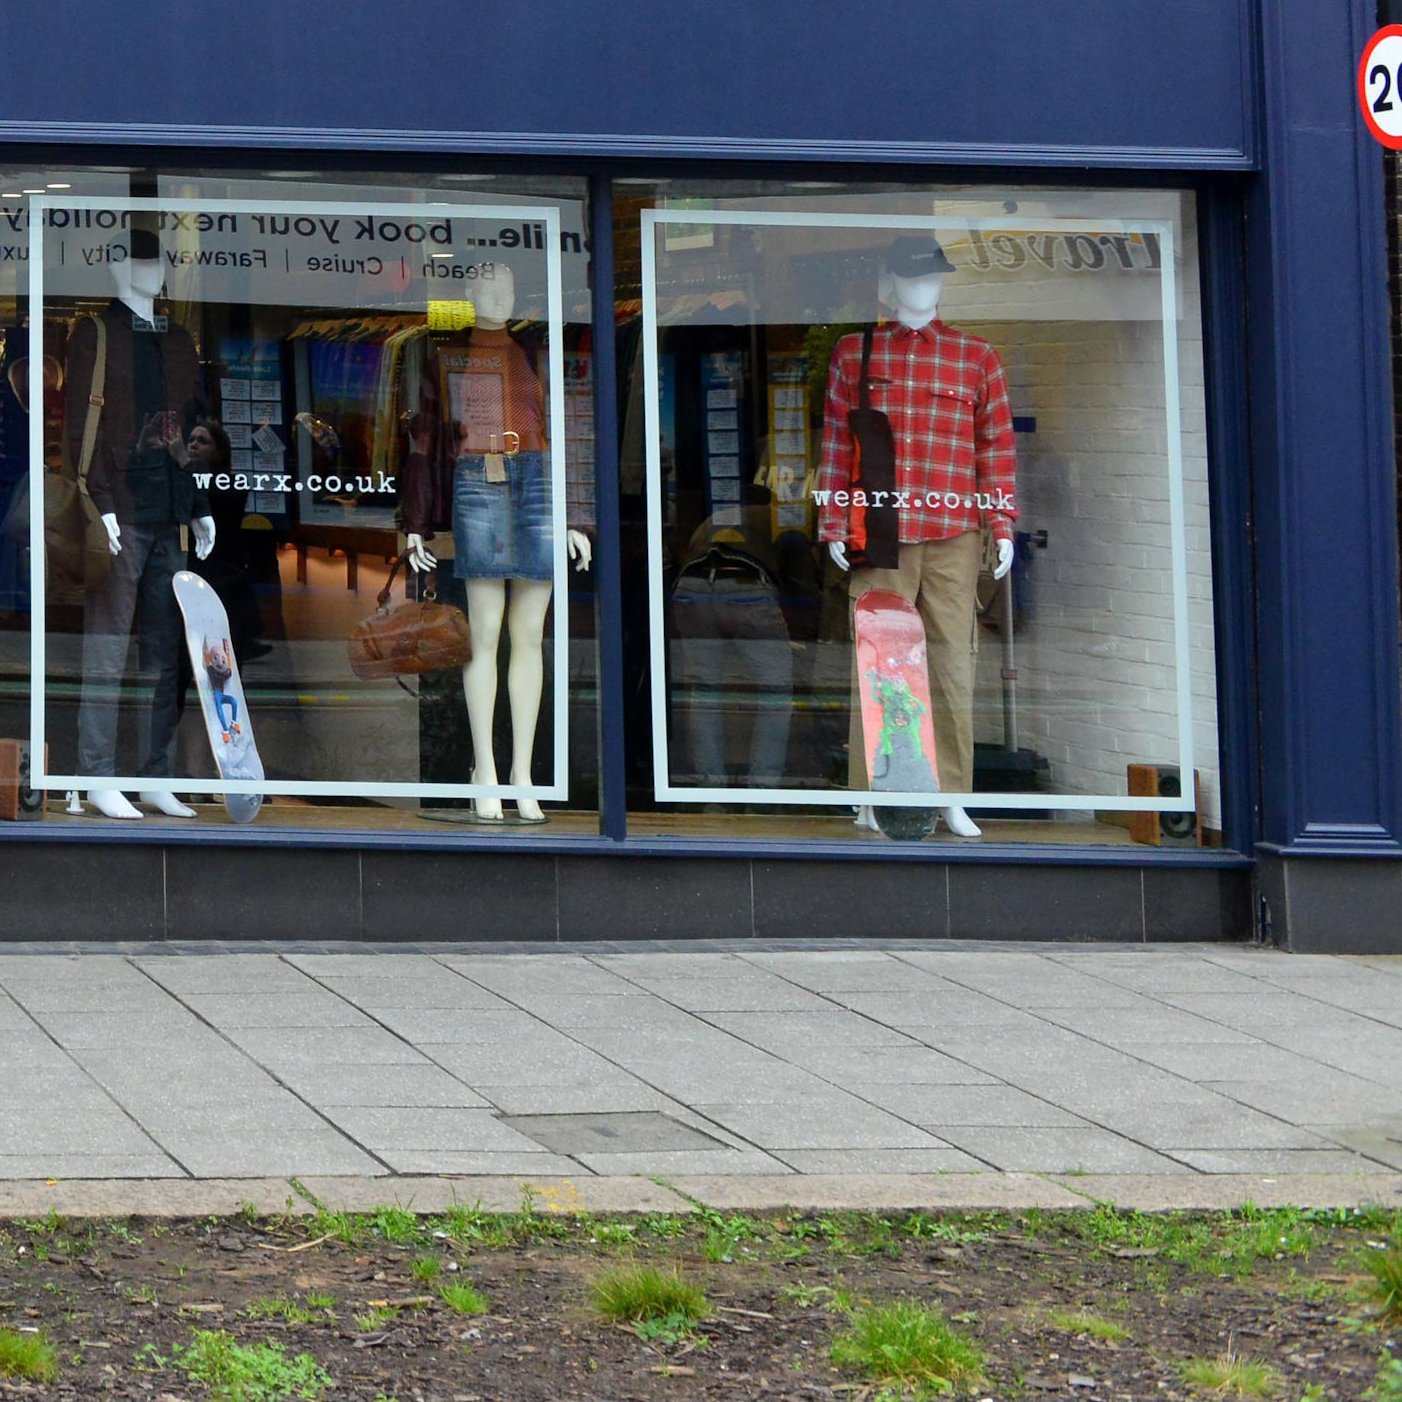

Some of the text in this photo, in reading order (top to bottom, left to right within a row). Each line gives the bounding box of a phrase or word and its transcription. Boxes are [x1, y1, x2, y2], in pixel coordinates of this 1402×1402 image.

[1369, 62, 1402, 113] 2
[192, 468, 397, 495] wearx.co.uk
[812, 486, 1015, 512] wearx.co.uk
